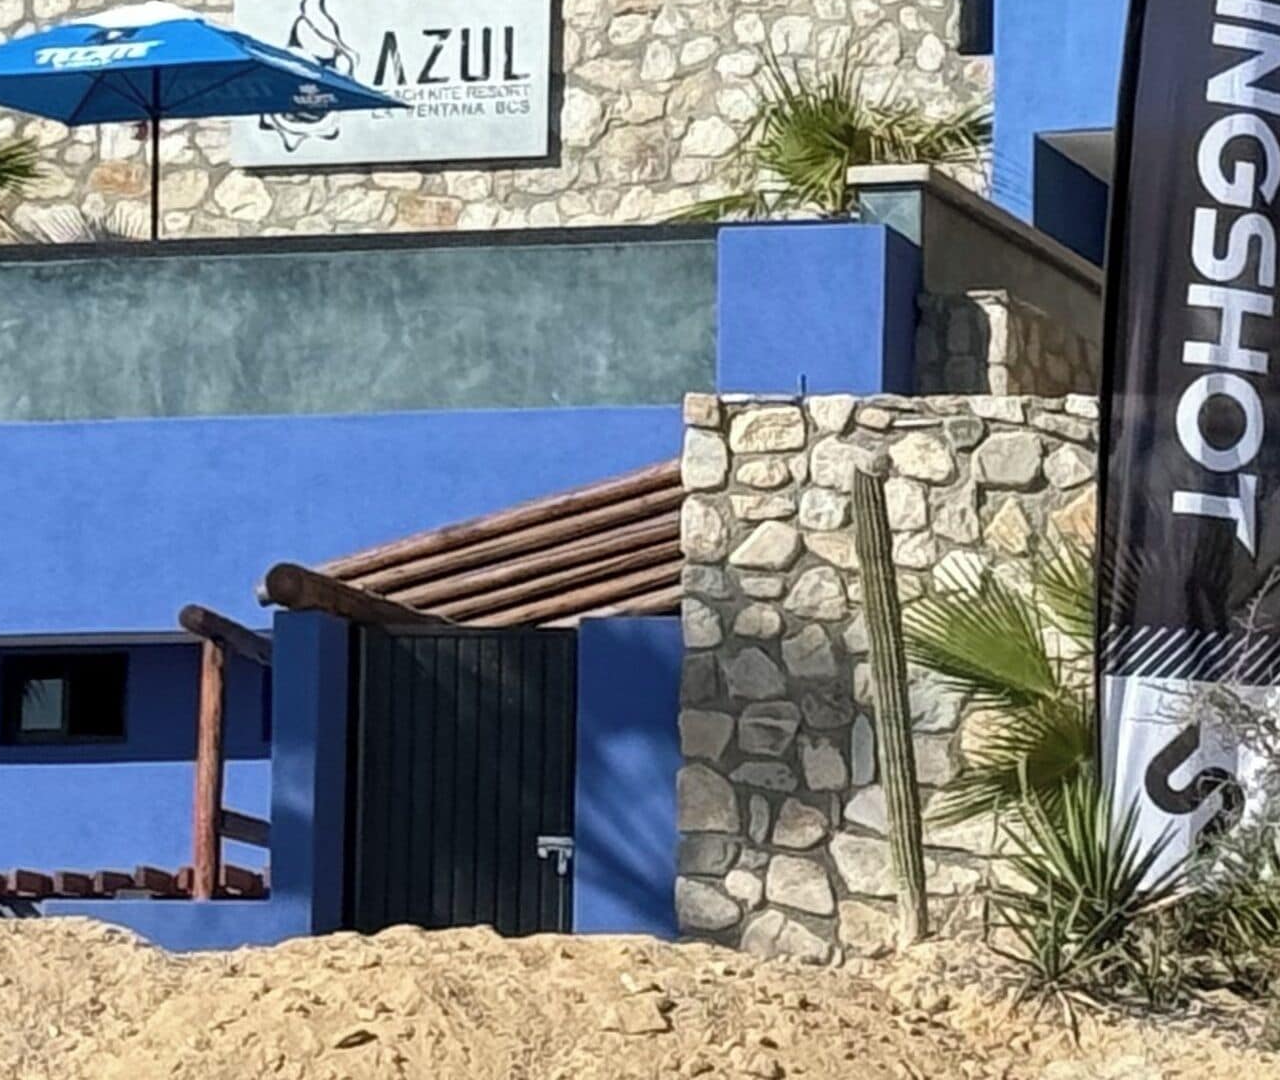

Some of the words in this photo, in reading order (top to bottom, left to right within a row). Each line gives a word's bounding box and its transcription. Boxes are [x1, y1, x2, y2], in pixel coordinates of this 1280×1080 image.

[372, 25, 532, 87] AZUL
[428, 86, 462, 101] KITE
[466, 83, 532, 99] RESORT
